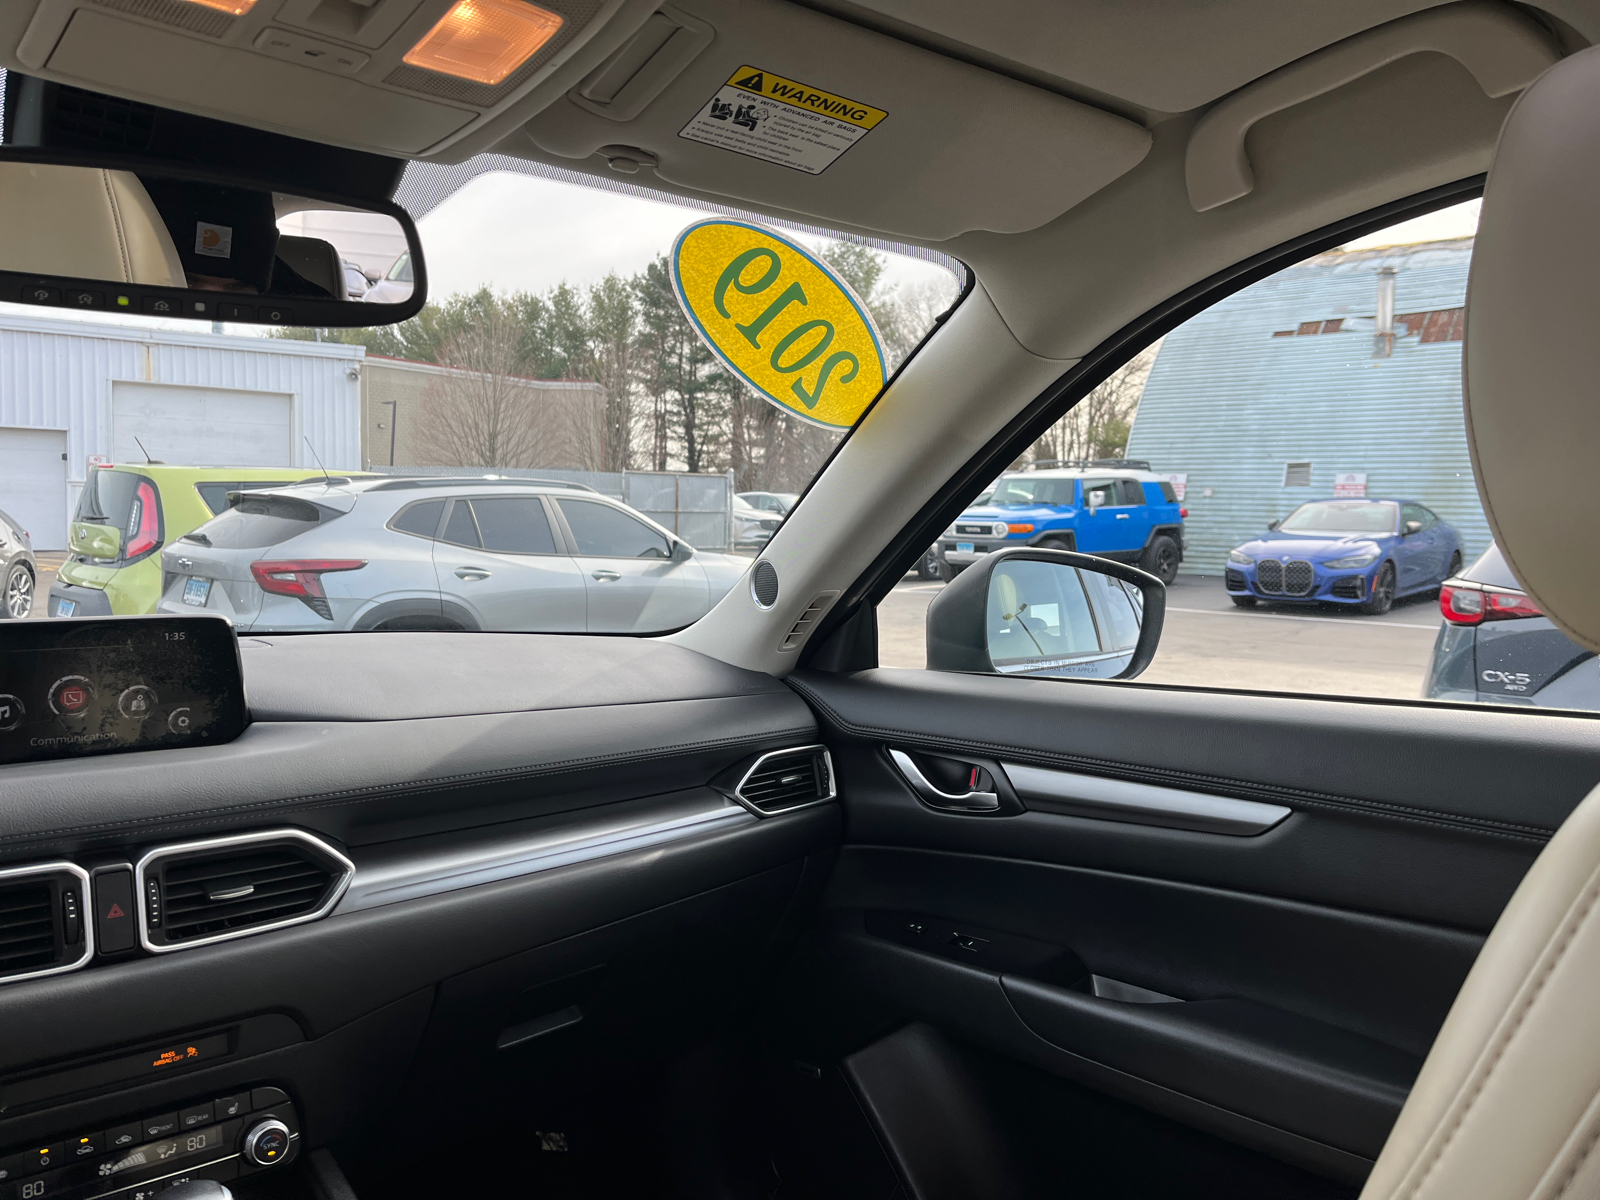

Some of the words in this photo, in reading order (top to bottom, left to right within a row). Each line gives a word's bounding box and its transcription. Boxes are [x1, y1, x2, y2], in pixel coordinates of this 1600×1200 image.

[770, 82, 868, 121] WARNING
[736, 92, 757, 102] EVEN
[758, 99, 779, 109] WITH
[780, 106, 821, 121] ADVANCED
[835, 123, 858, 133] BAGS
[164, 631, 186, 641] 1:35
[1482, 670, 1531, 684] CX-5
[30, 731, 117, 746] Communication
[152, 1057, 173, 1067] AIRBAG
[173, 1054, 184, 1062] OFF
[160, 1050, 176, 1059] PASS
[197, 1113, 209, 1121] REAR
[158, 1123, 173, 1131] FRONT
[187, 1134, 206, 1152] 80
[263, 1139, 280, 1150] SYNC
[22, 1181, 45, 1199] 80
